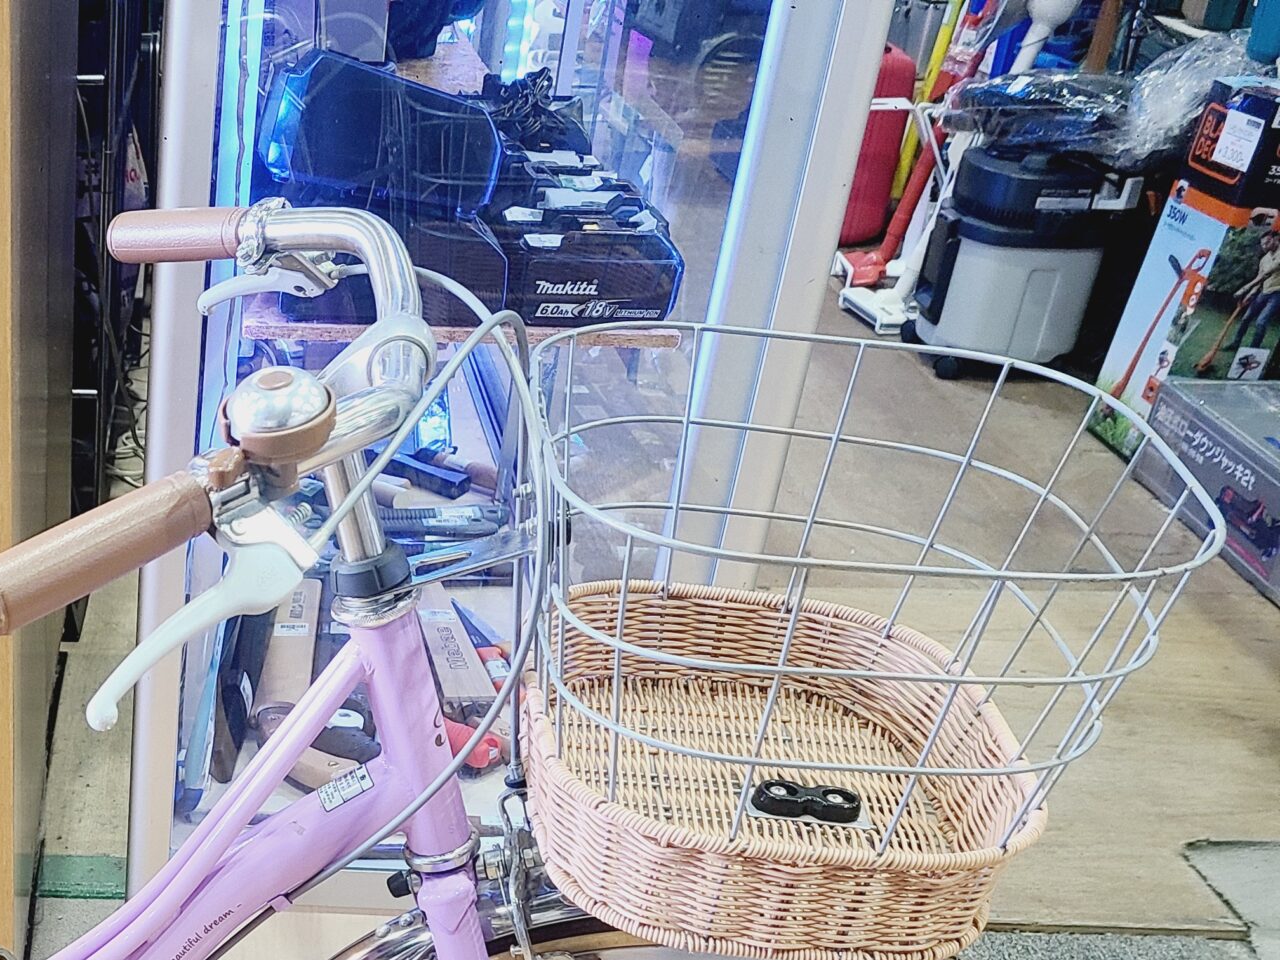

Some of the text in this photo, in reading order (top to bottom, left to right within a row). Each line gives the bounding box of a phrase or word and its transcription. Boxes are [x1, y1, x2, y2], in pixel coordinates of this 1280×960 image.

[1167, 205, 1188, 226] 350W
[540, 304, 570, 317] 6.0Ah
[203, 908, 234, 935] dream
